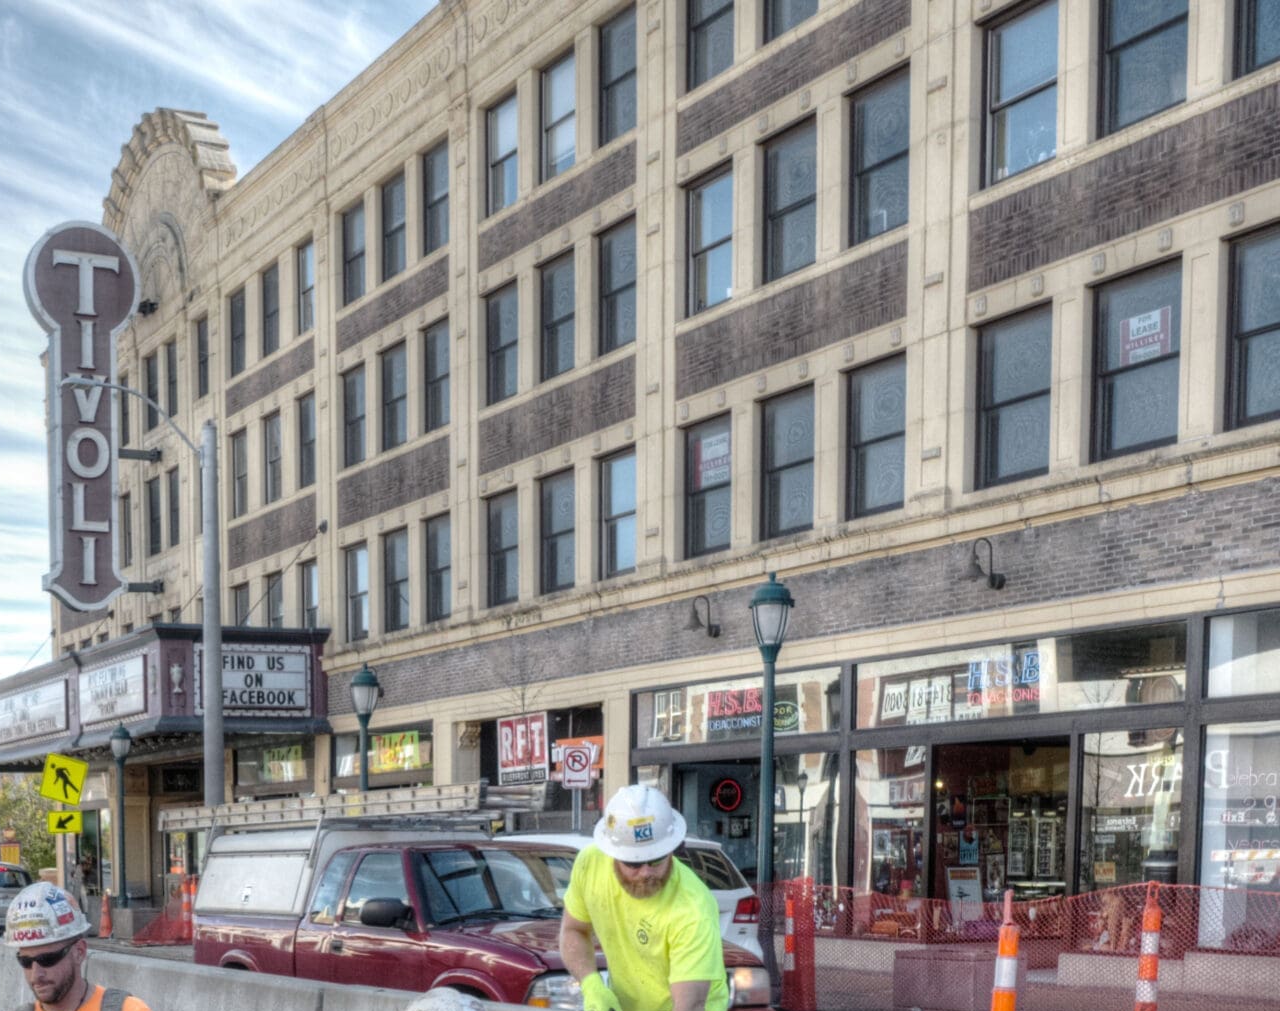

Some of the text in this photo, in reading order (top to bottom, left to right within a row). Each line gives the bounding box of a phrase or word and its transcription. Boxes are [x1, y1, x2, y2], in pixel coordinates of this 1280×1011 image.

[1131, 320, 1159, 337] LEASE
[52, 249, 119, 585] TIVOLI
[223, 655, 285, 671] FIND US
[244, 673, 263, 688] ON
[222, 689, 296, 705] FACEBOOK
[708, 688, 763, 718] H.S.B.
[501, 721, 543, 761] RFT
[634, 825, 653, 840] KCI
[13, 928, 46, 942] LOCAL
